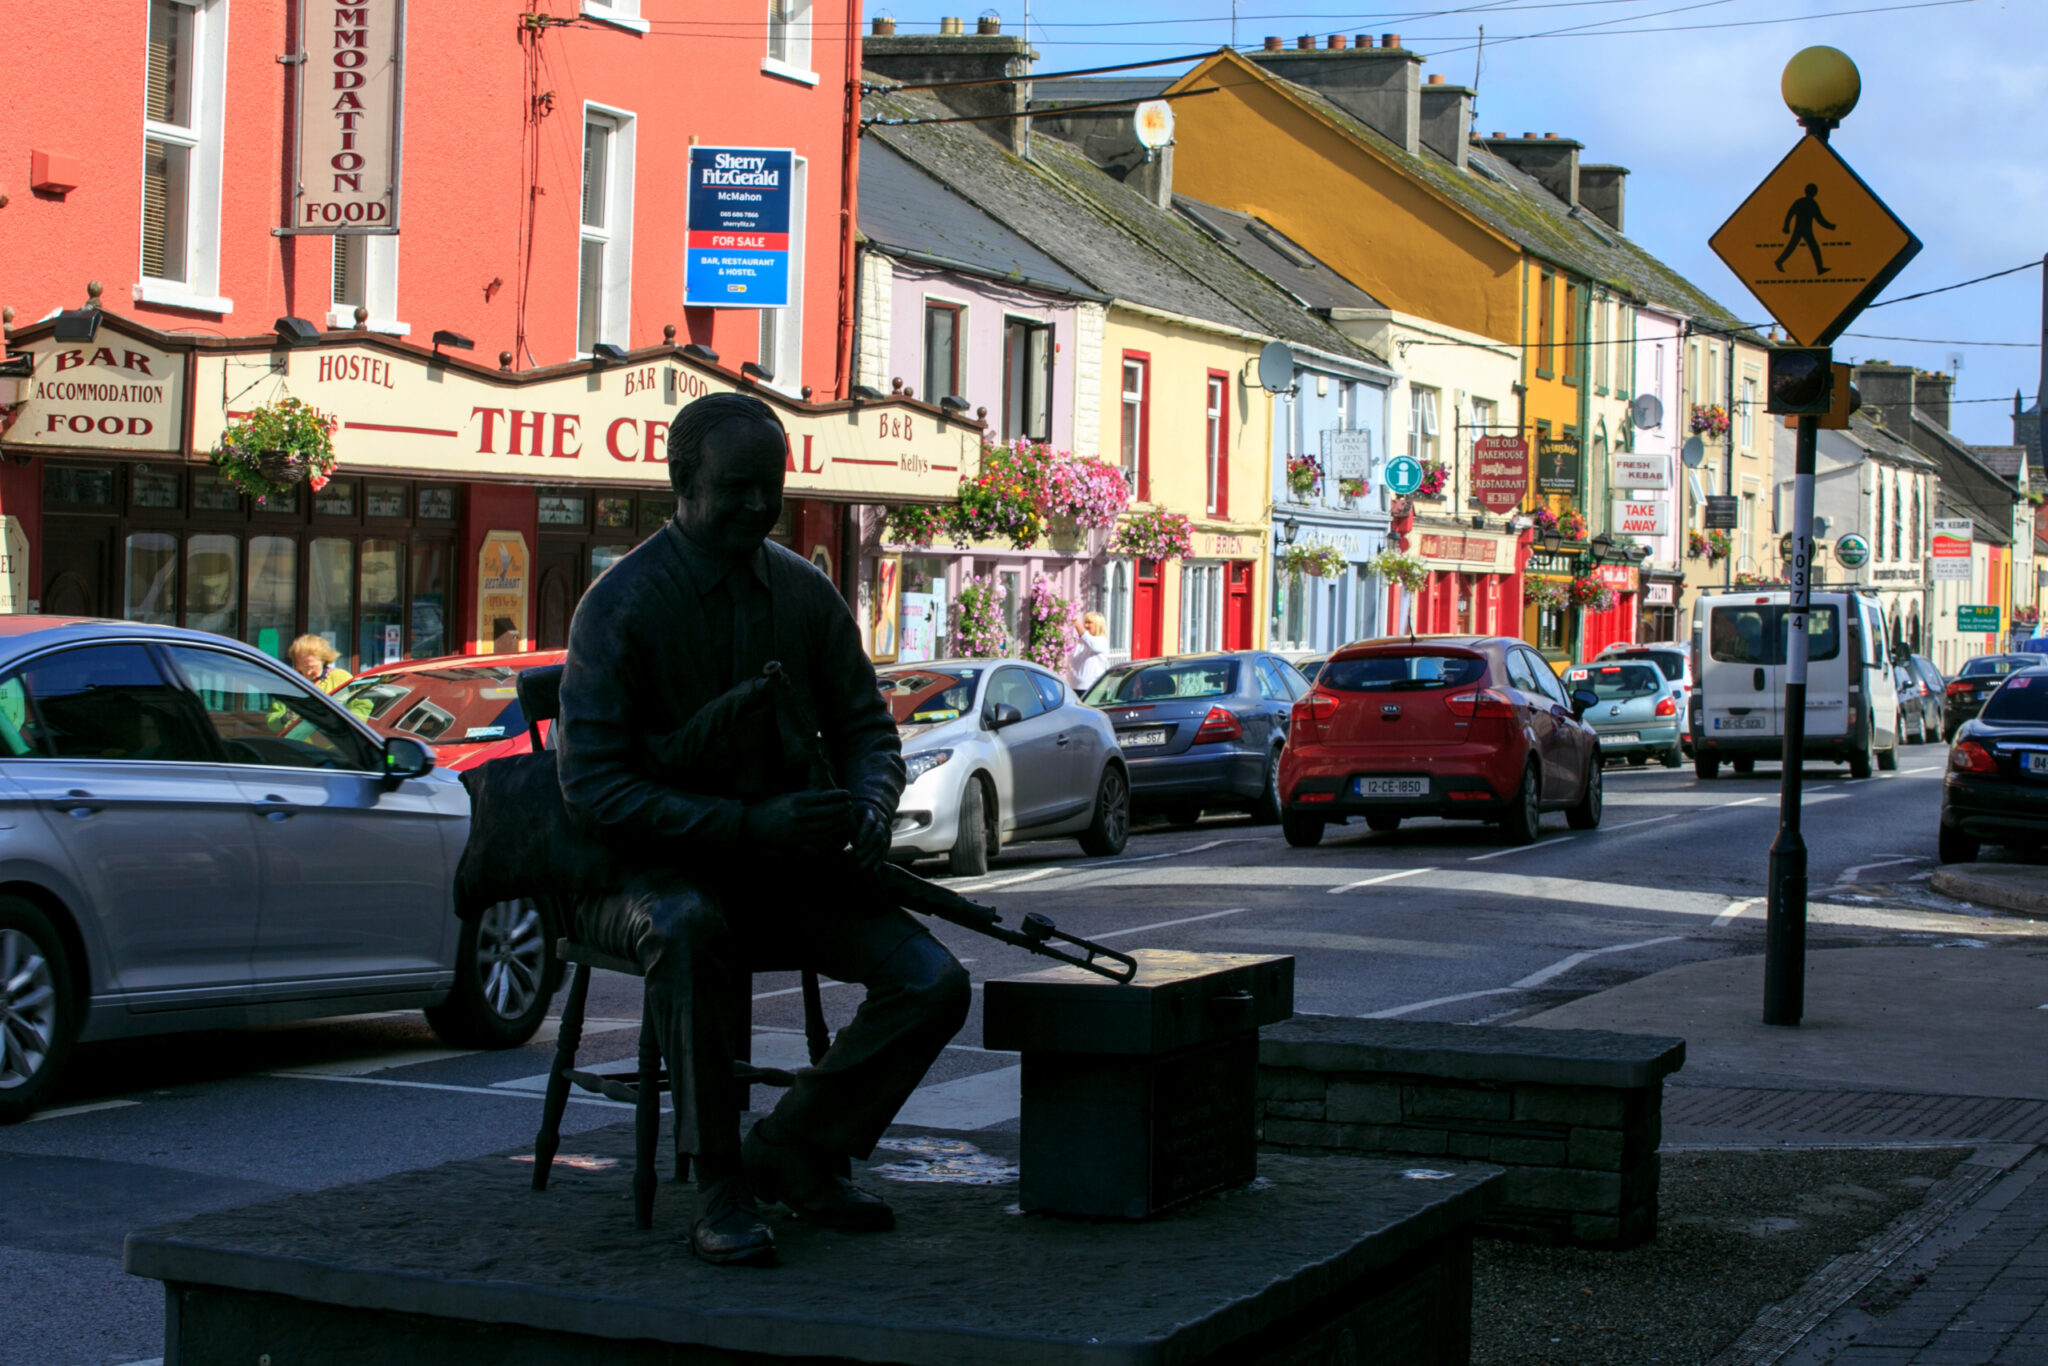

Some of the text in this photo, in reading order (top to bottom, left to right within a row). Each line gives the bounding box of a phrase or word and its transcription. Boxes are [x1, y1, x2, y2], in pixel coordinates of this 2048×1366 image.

[332, 0, 369, 193] MMODATION
[715, 153, 766, 173] Sherry
[702, 169, 779, 186] FitzGerald
[718, 192, 762, 202] McMahon
[305, 202, 387, 223] FOOD
[712, 235, 766, 248] FOR SALE
[701, 257, 776, 267] BAR, RESTAURANT
[718, 268, 757, 277] & HOSTEL
[55, 347, 153, 377] BAR
[318, 354, 395, 390] HOSTEL
[625, 367, 709, 398] BAR FOOD
[36, 382, 163, 404] ACCOMMODATION
[47, 414, 153, 436] FOOD
[470, 406, 583, 460] THE
[1486, 439, 1518, 448] THE OLD
[1478, 450, 1524, 460] BAKEHOUSE
[901, 453, 928, 478] Kelly's
[1616, 461, 1650, 469] FRESH
[1628, 472, 1663, 480] KEBAB
[1476, 480, 1526, 488] RESTAURANT
[1625, 505, 1656, 517] TAKE
[1622, 520, 1657, 532] AWAY
[1976, 607, 1993, 615] N67
[1368, 780, 1421, 793] 12-CE-1850
